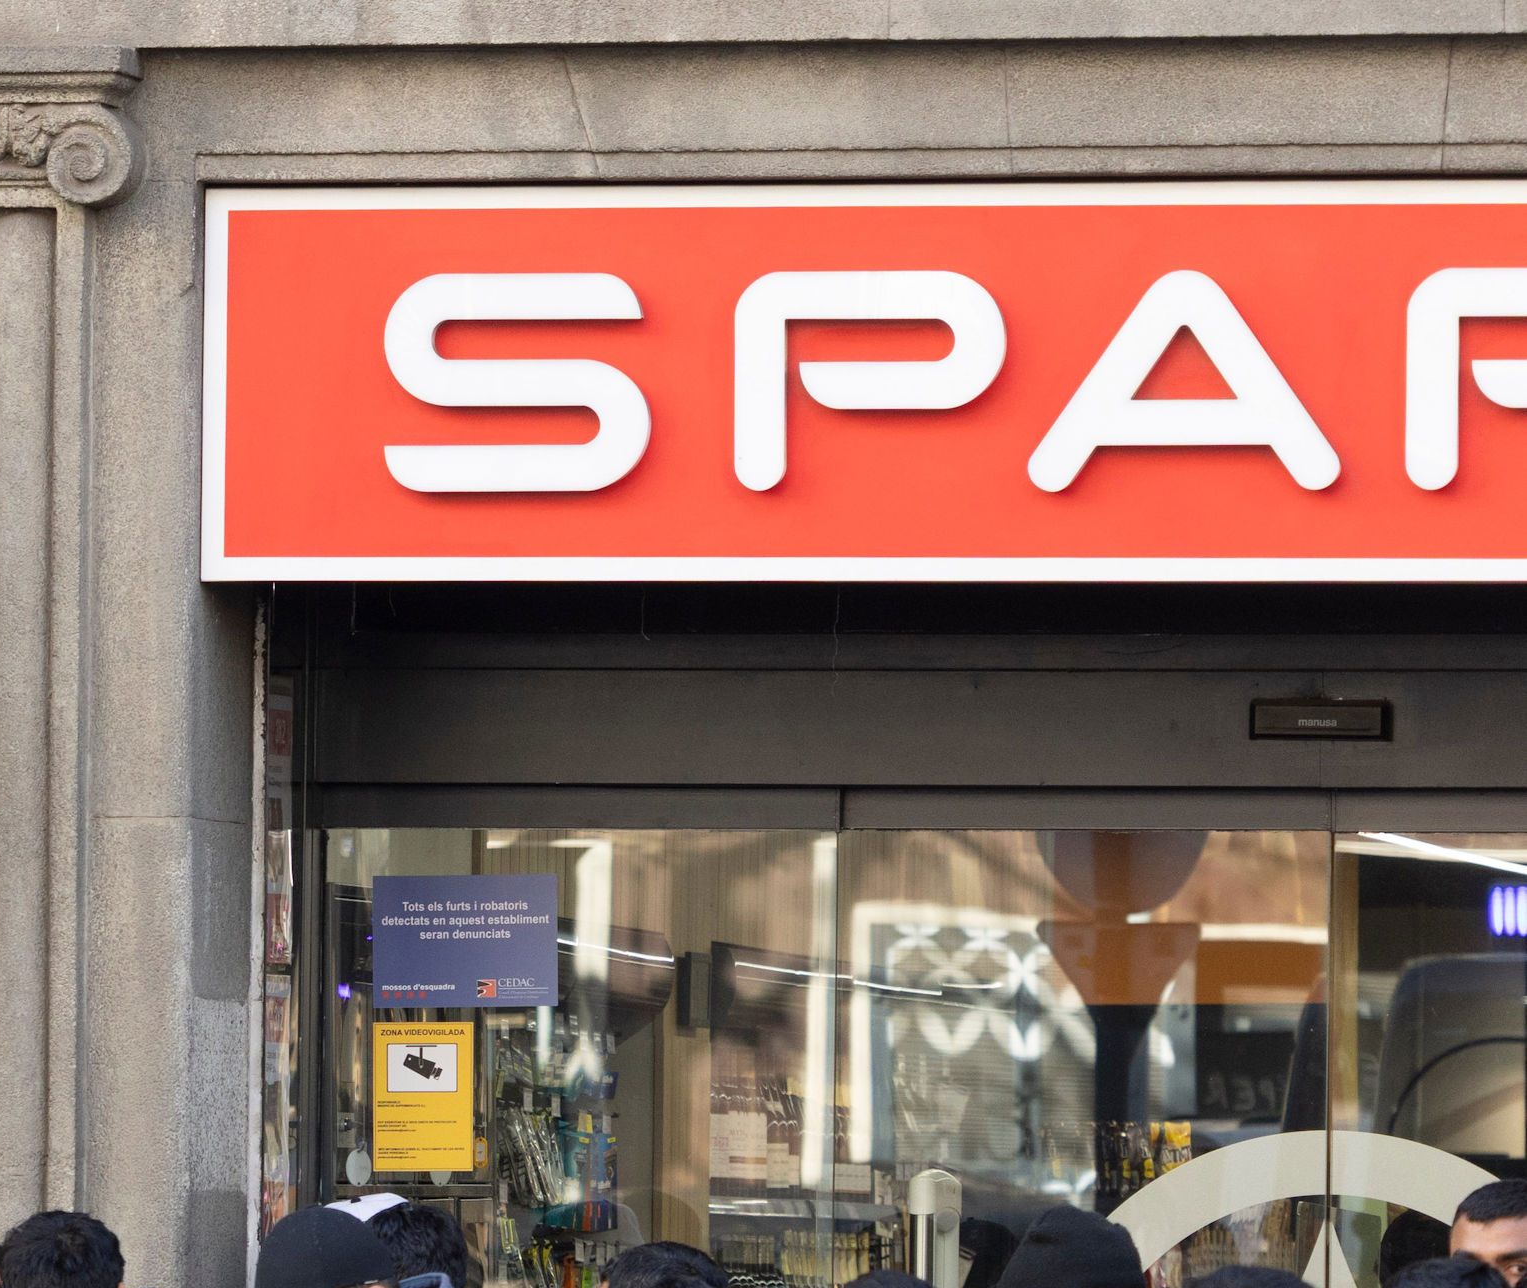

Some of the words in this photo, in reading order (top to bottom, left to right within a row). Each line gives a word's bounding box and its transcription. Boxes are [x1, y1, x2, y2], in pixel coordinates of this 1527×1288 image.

[1298, 718, 1338, 727] manusa
[402, 901, 425, 912] Tots
[427, 901, 444, 912] els
[446, 901, 471, 911] furts
[474, 901, 478, 911] i
[480, 900, 529, 911] robatoris
[381, 915, 430, 926] detectats
[433, 917, 446, 925] en
[449, 915, 485, 928] aquest
[487, 914, 550, 925] establiment
[419, 931, 449, 940] seran
[452, 928, 511, 939] denunciats
[497, 977, 535, 987] CEDAC
[413, 983, 456, 992] d'esquadra
[404, 1028, 465, 1036] VIDEOVIGILADA
